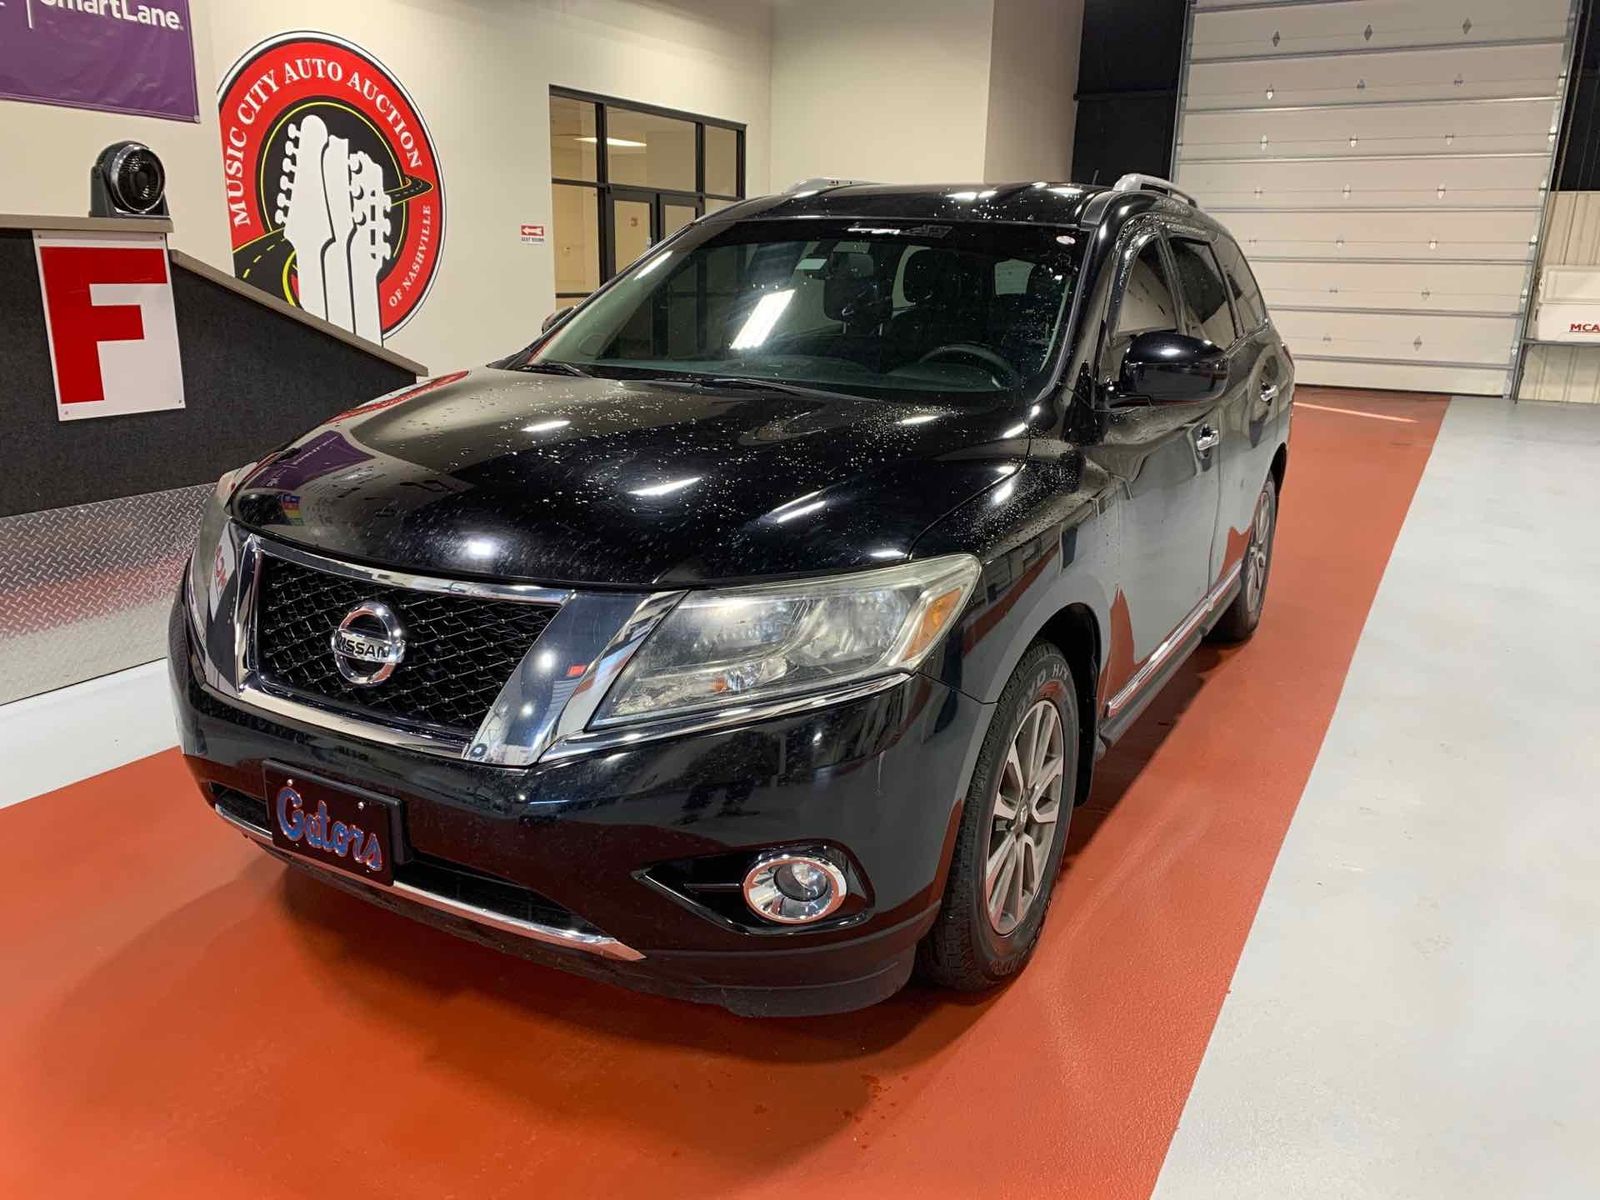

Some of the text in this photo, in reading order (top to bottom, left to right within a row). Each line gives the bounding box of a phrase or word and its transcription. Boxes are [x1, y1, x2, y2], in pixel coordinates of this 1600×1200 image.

[40, 0, 181, 30] martLane
[226, 58, 423, 228] MUSIC CITY AUTO AUCTION
[388, 205, 432, 308] OF NASHVILLE
[39, 246, 168, 404] F
[334, 634, 391, 658] NISSAN
[276, 786, 382, 871] Gators
